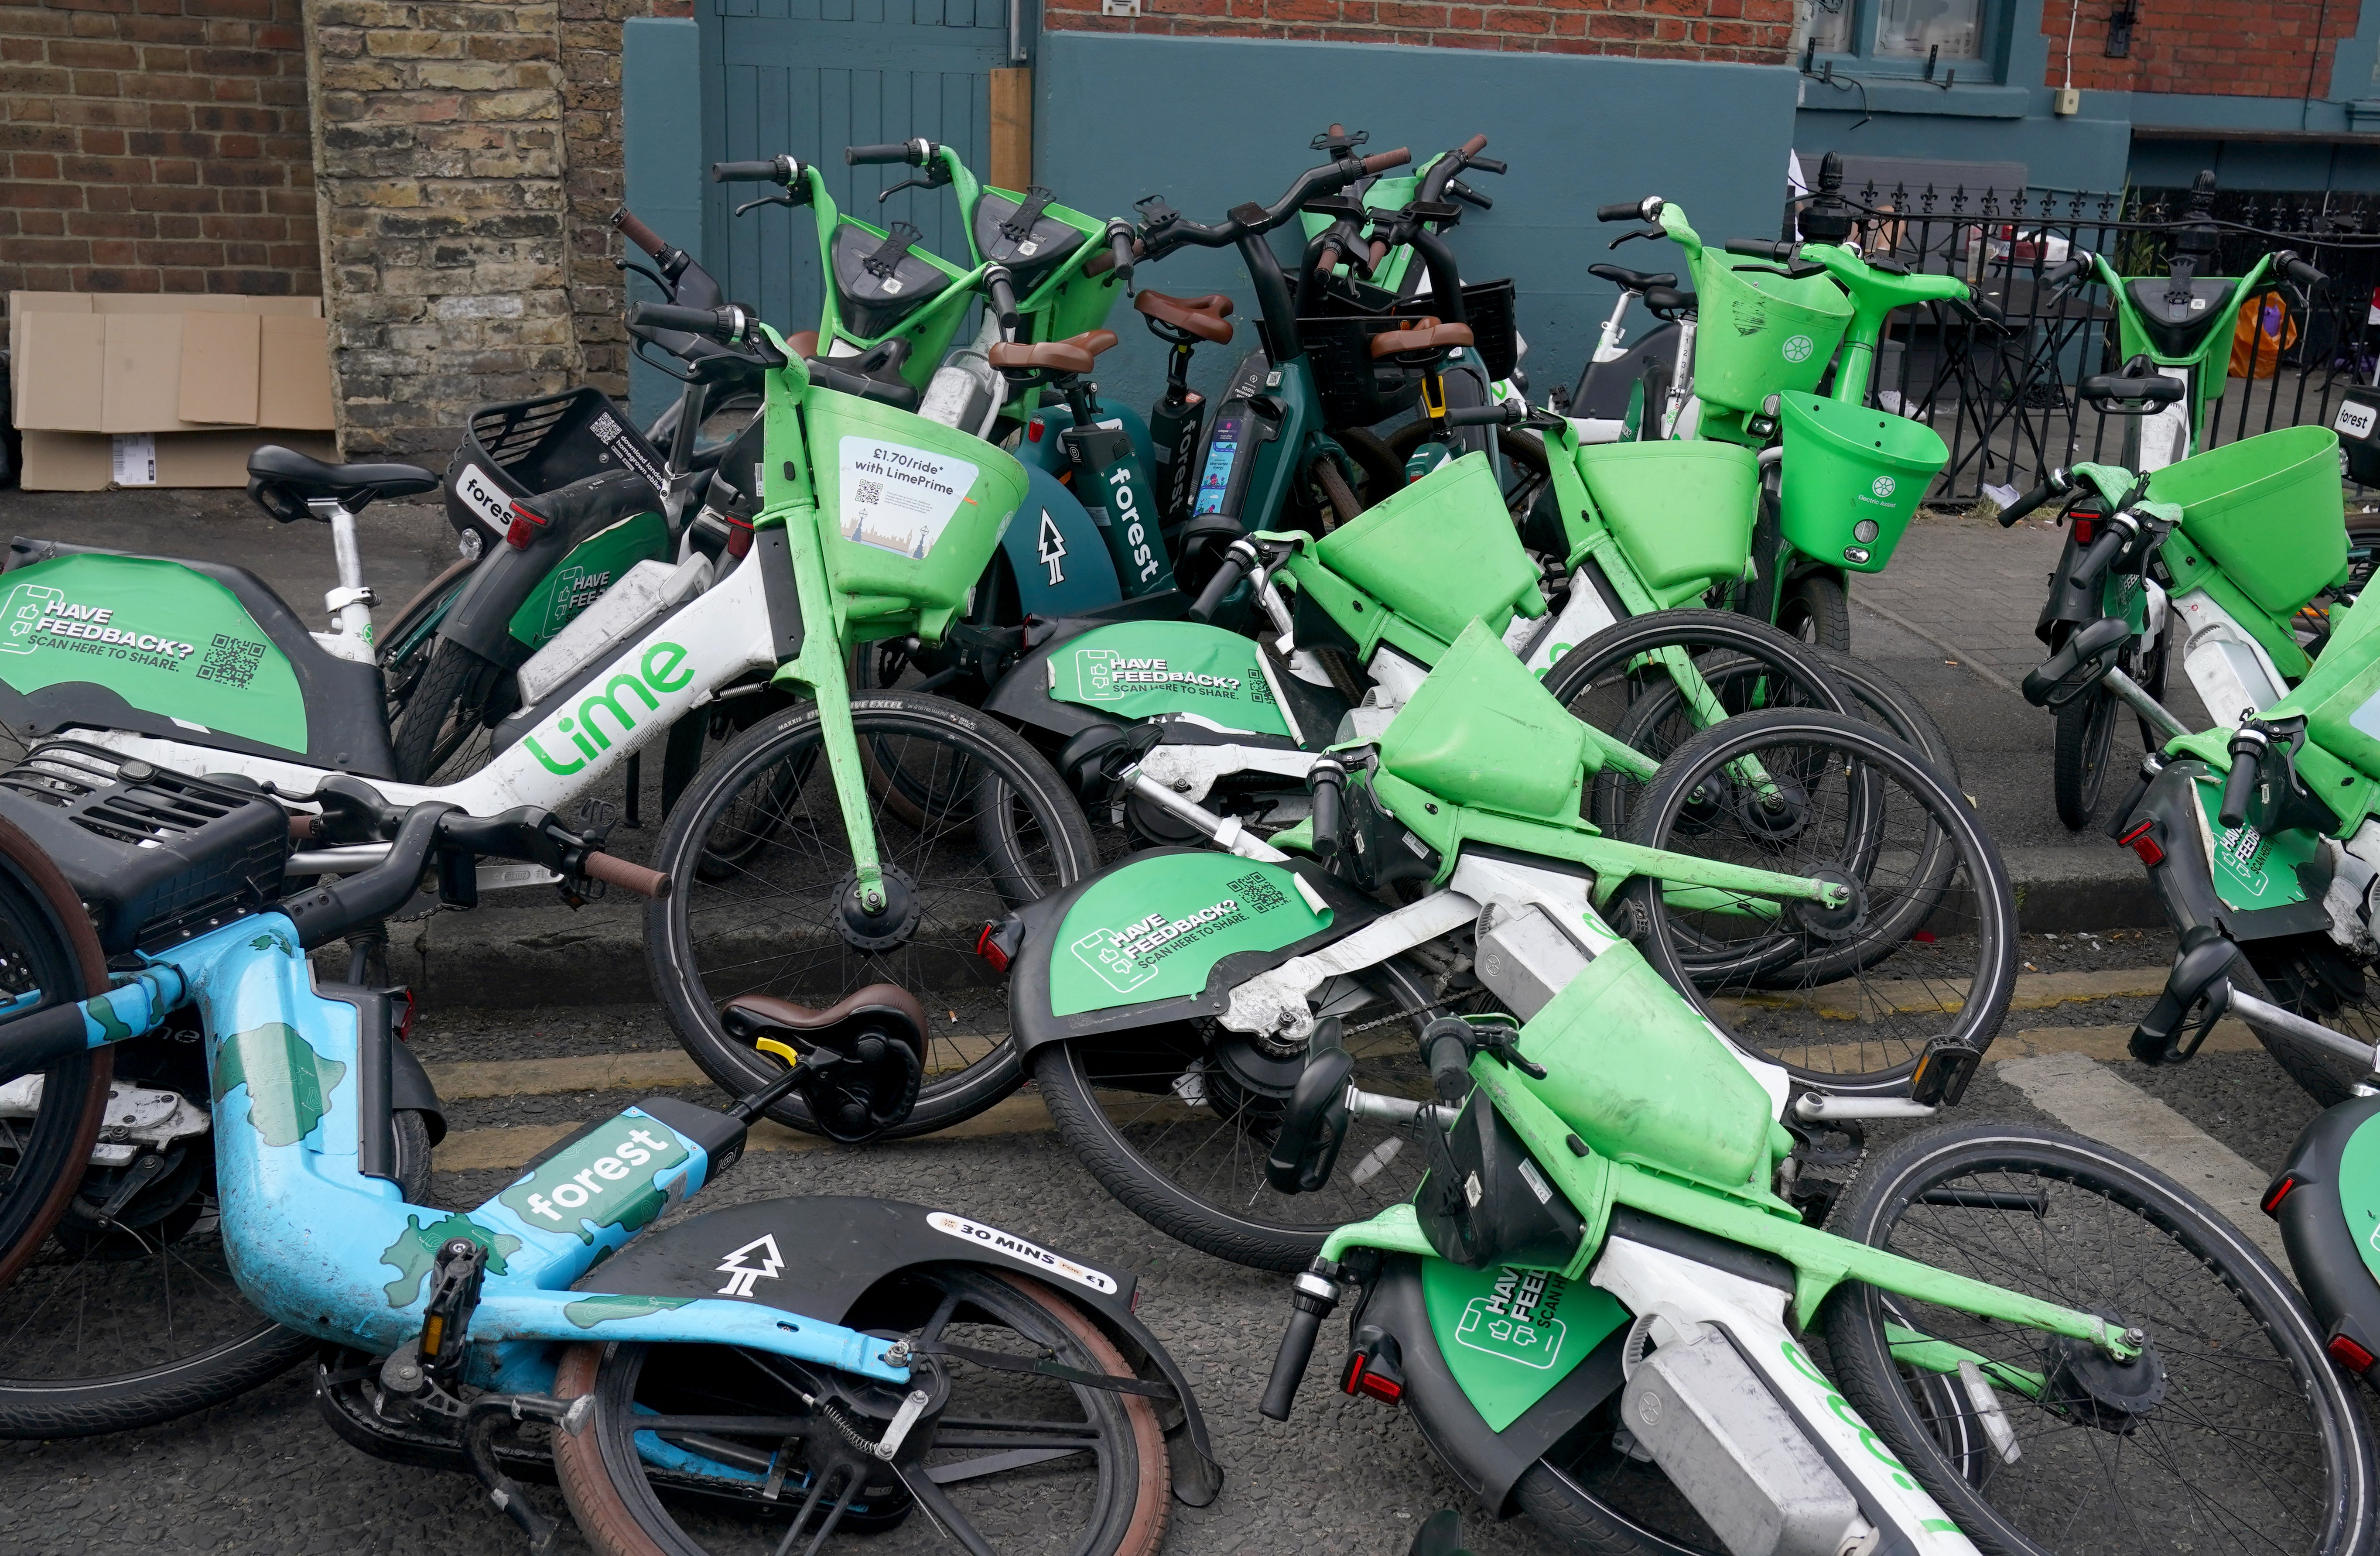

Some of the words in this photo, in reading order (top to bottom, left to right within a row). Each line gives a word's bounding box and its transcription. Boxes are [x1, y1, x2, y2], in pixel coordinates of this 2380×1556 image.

[1242, 385, 1256, 394] 100%
[2339, 409, 2368, 429] forest
[616, 439, 648, 475] homegrown
[646, 474, 662, 490] ebike
[620, 435, 648, 464] download
[1169, 419, 1197, 514] forest
[855, 460, 883, 475] with
[886, 466, 954, 495] LimePrime
[466, 479, 513, 525] fores
[1858, 494, 1880, 505] Electric
[1109, 467, 1159, 583] forest
[573, 571, 610, 593] HAVE
[44, 600, 114, 625] HAVE
[27, 635, 69, 649] SCAN
[69, 641, 106, 656] HERE
[108, 648, 127, 660] TO
[129, 652, 180, 672] SHARE.
[35, 617, 195, 661] FEEDBACK?
[1110, 658, 1168, 671] HAVE
[1111, 671, 1242, 691] FEEDBACK?
[523, 641, 696, 776] Lime
[1149, 683, 1178, 692] HERE
[1180, 685, 1197, 694] TO
[1199, 688, 1240, 700] SHARE.
[778, 716, 803, 732] MAXXIS
[958, 721, 975, 731] SHIELD
[959, 717, 977, 727] SILK
[2234, 825, 2263, 866] FEEDB
[2250, 854, 2267, 874] SCAN
[1108, 913, 1169, 949] HAVE
[1122, 899, 1241, 960] FEEDBACK?
[1138, 947, 1173, 969] SCAN
[1170, 932, 1200, 952] HERE
[1196, 927, 1214, 938] TO
[1212, 913, 1250, 931] SHARE.
[527, 1129, 669, 1221] forest
[961, 1224, 992, 1240] 30
[995, 1236, 1055, 1265] MINS
[1061, 1263, 1080, 1274] FOR
[1485, 1266, 1524, 1315] HAV
[1536, 1290, 1563, 1329] SCAN
